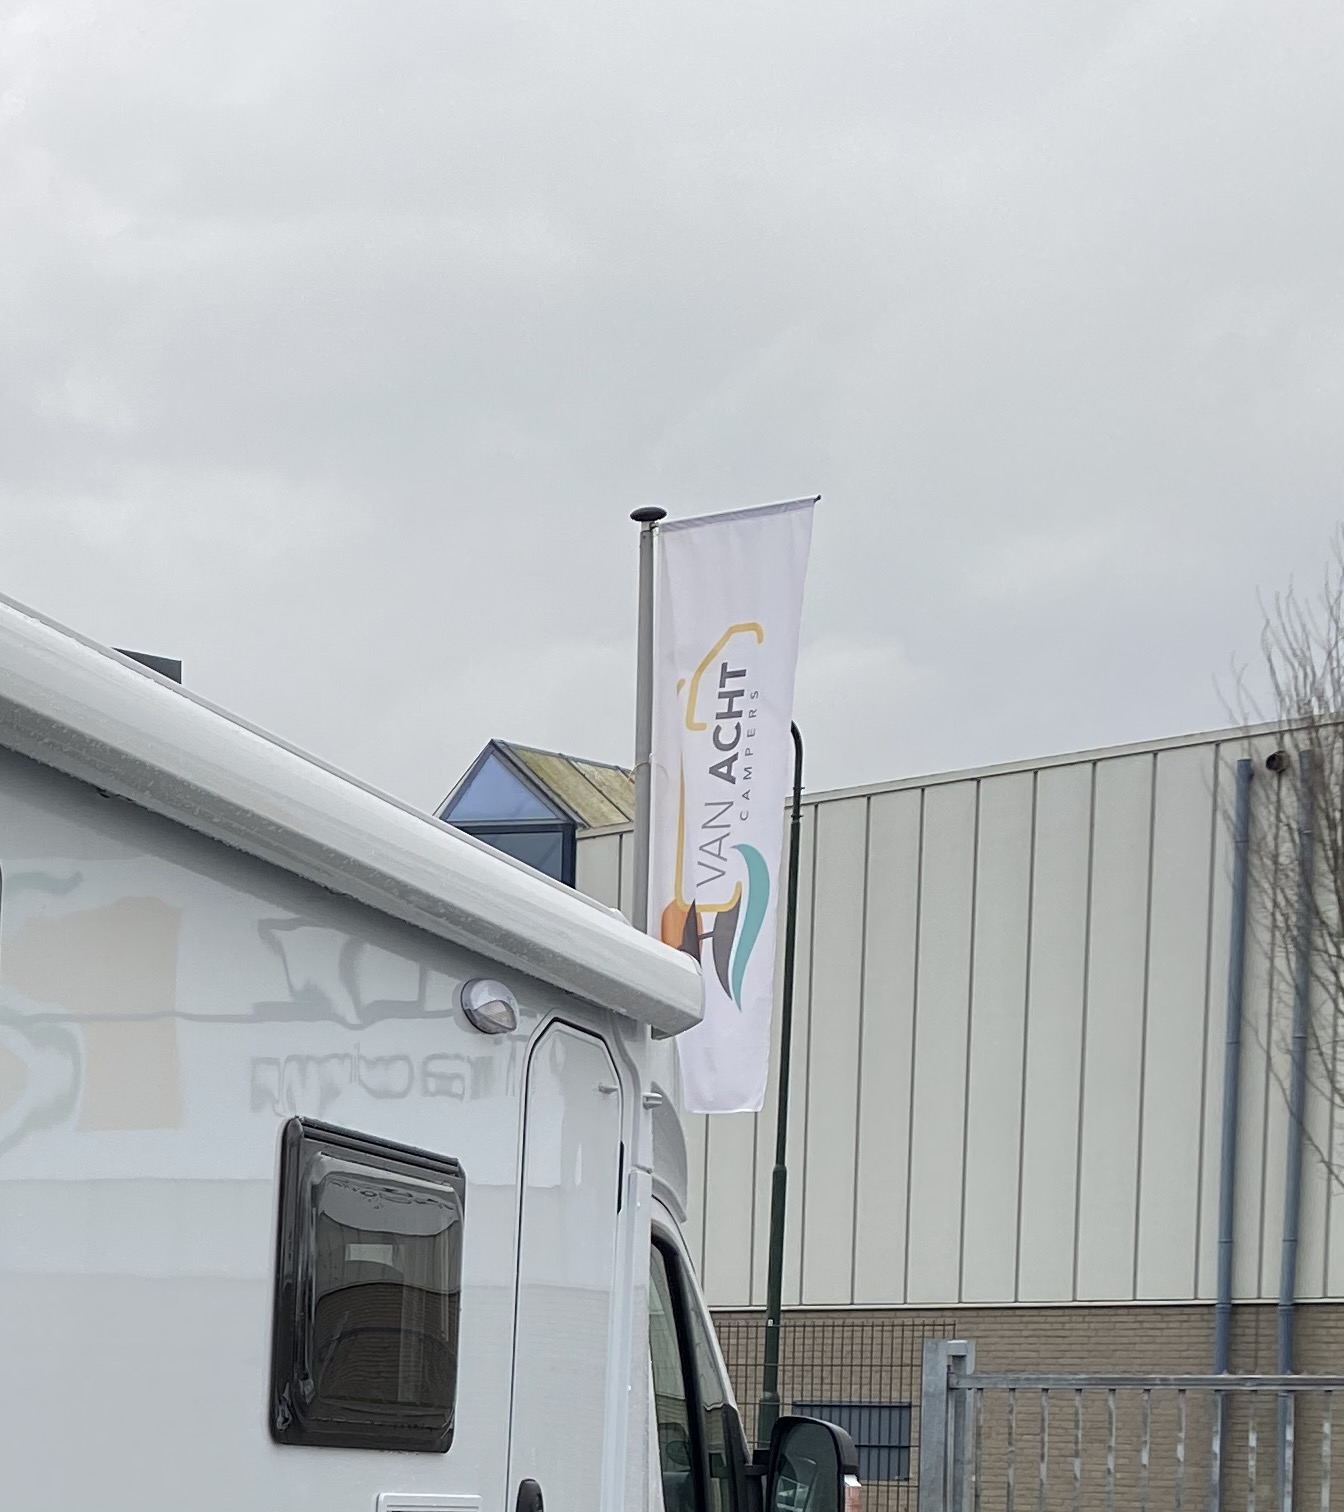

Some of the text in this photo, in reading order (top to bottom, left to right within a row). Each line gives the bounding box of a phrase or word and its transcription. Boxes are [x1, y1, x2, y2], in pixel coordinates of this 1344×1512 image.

[696, 662, 747, 888] VAN ACHT
[739, 690, 759, 821] CAMPERS
